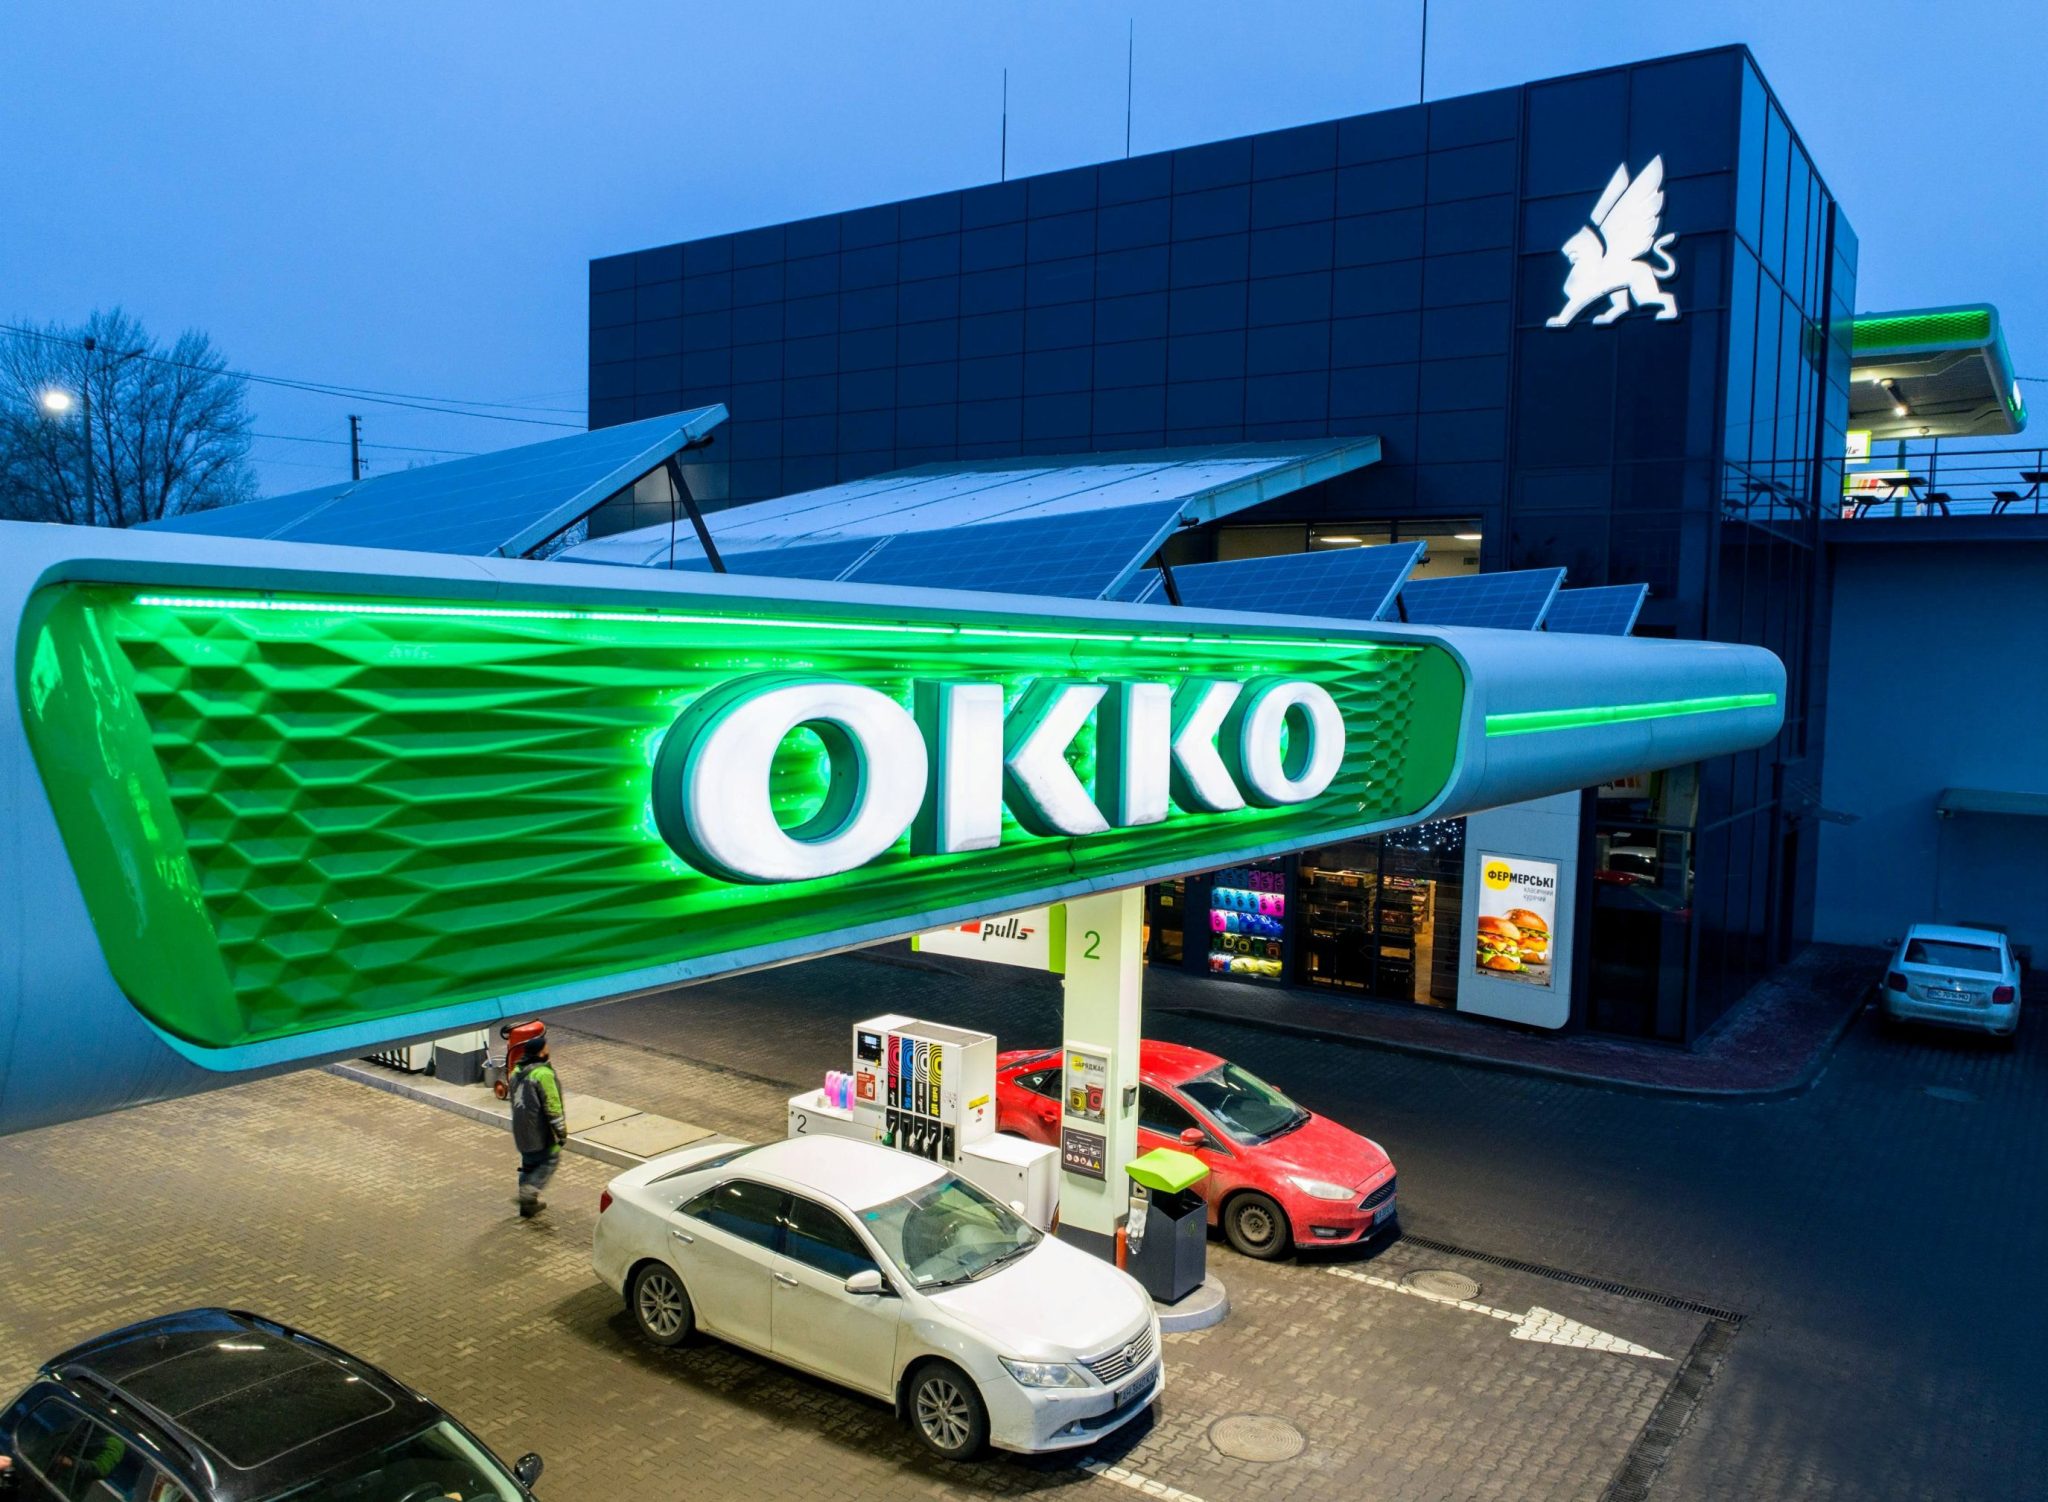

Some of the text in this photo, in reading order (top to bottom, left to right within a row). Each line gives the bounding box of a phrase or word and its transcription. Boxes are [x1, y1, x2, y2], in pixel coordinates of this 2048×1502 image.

[662, 674, 1346, 885] OKKO
[1487, 869, 1555, 889] ФЕРМЕРСЬКІ
[981, 917, 1035, 942] pulls
[1083, 929, 1101, 961] 2
[797, 1114, 807, 1134] 2
